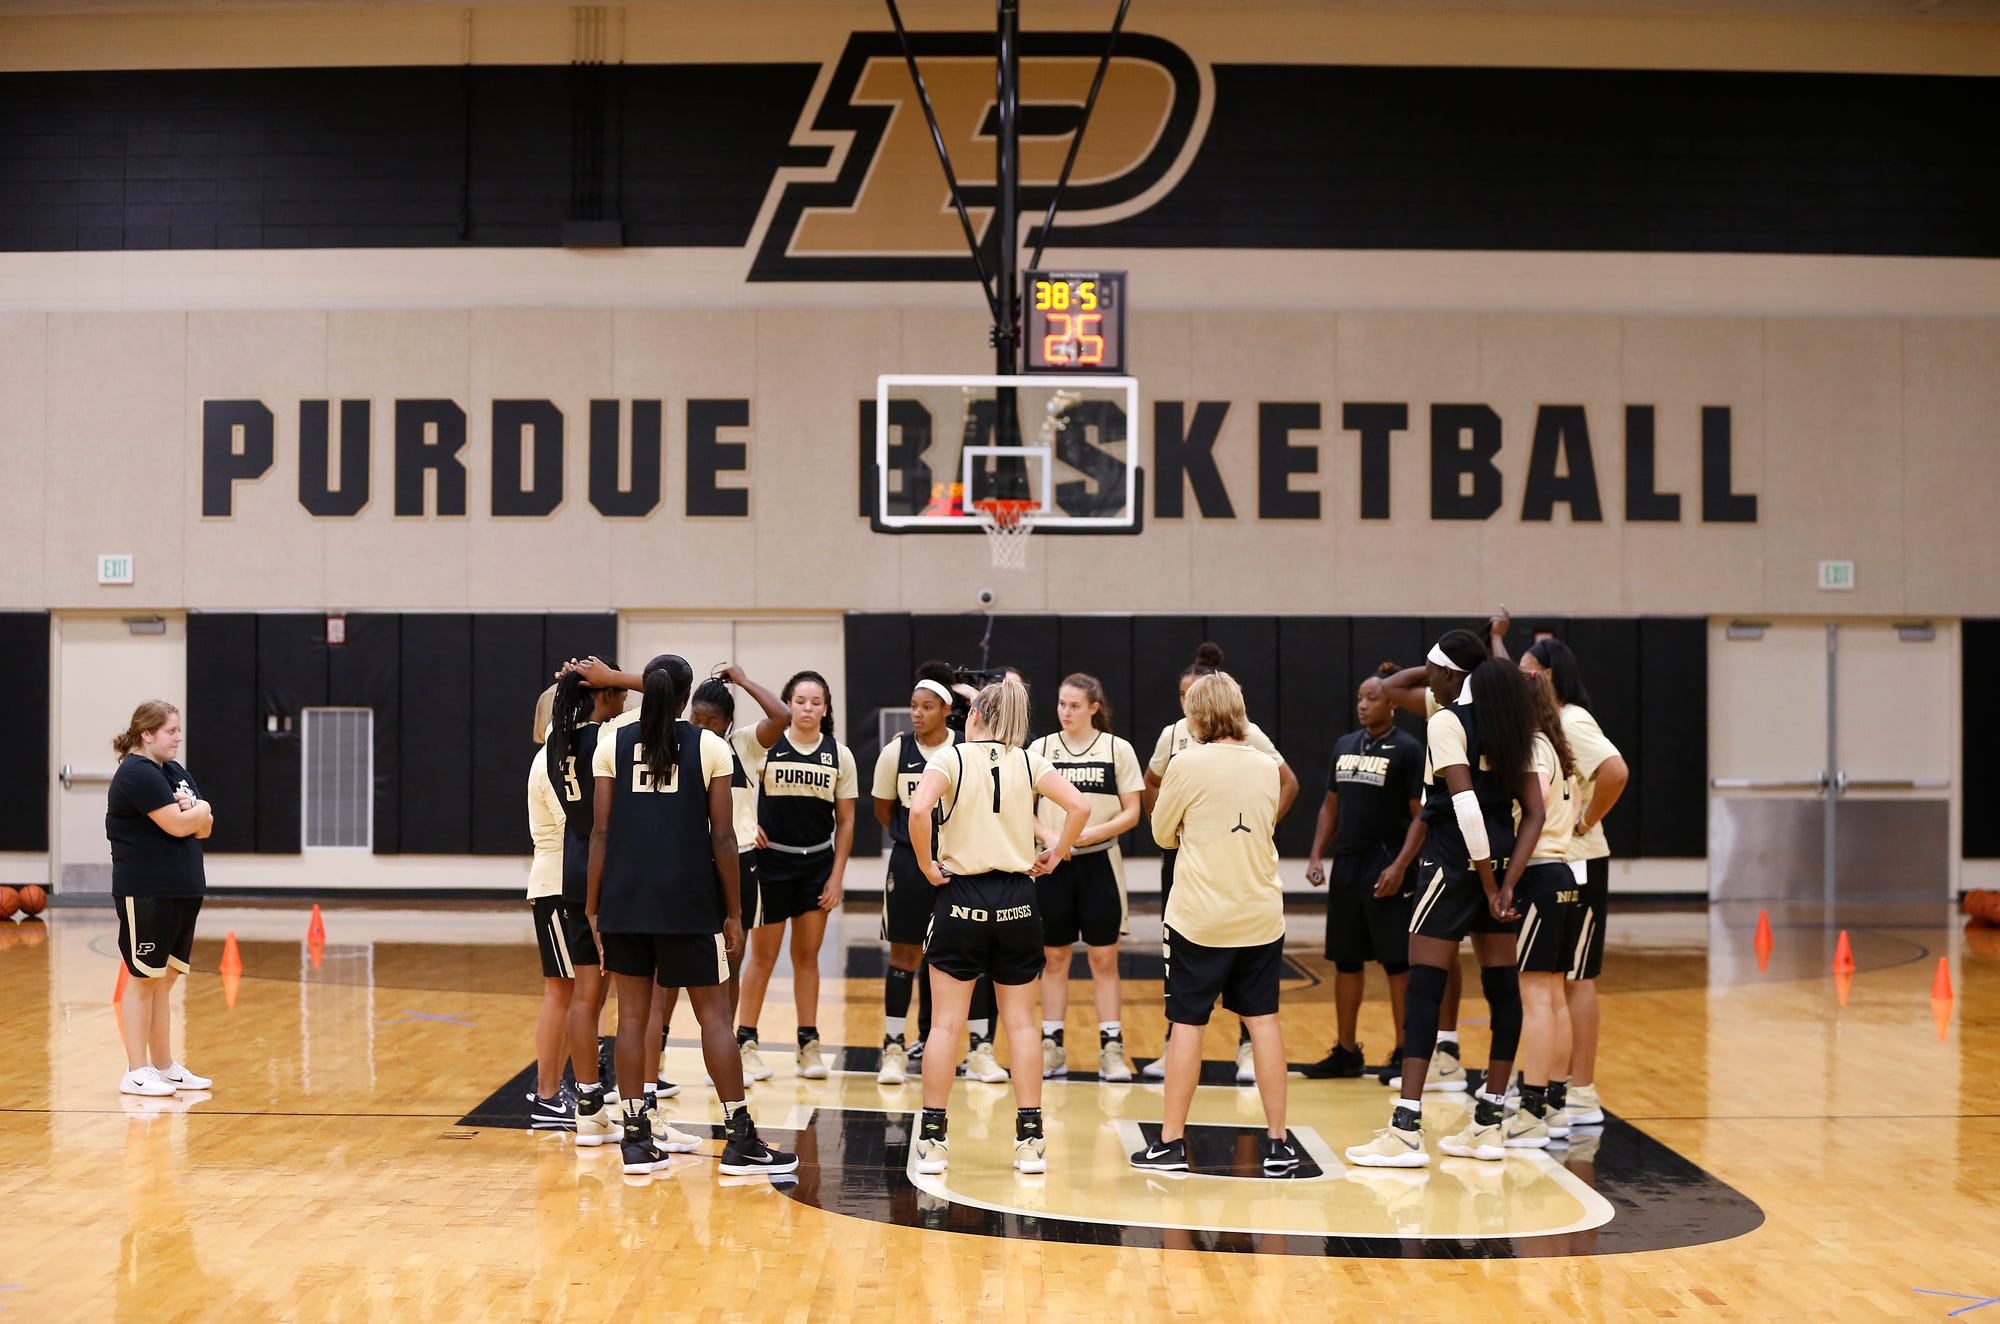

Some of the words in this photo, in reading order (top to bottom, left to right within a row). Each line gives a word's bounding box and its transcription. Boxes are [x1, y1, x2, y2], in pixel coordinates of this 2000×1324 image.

[1043, 312, 1105, 365] 25
[201, 398, 751, 518] PURDUE
[858, 399, 1758, 523] BASKETBALL
[103, 559, 129, 579] EXIT
[775, 769, 831, 789] PURDUE
[1058, 767, 1105, 783] URDUE
[991, 766, 1001, 814] 1
[950, 905, 988, 922] NO
[996, 904, 1032, 922] EXCUSES
[136, 942, 156, 956] P
